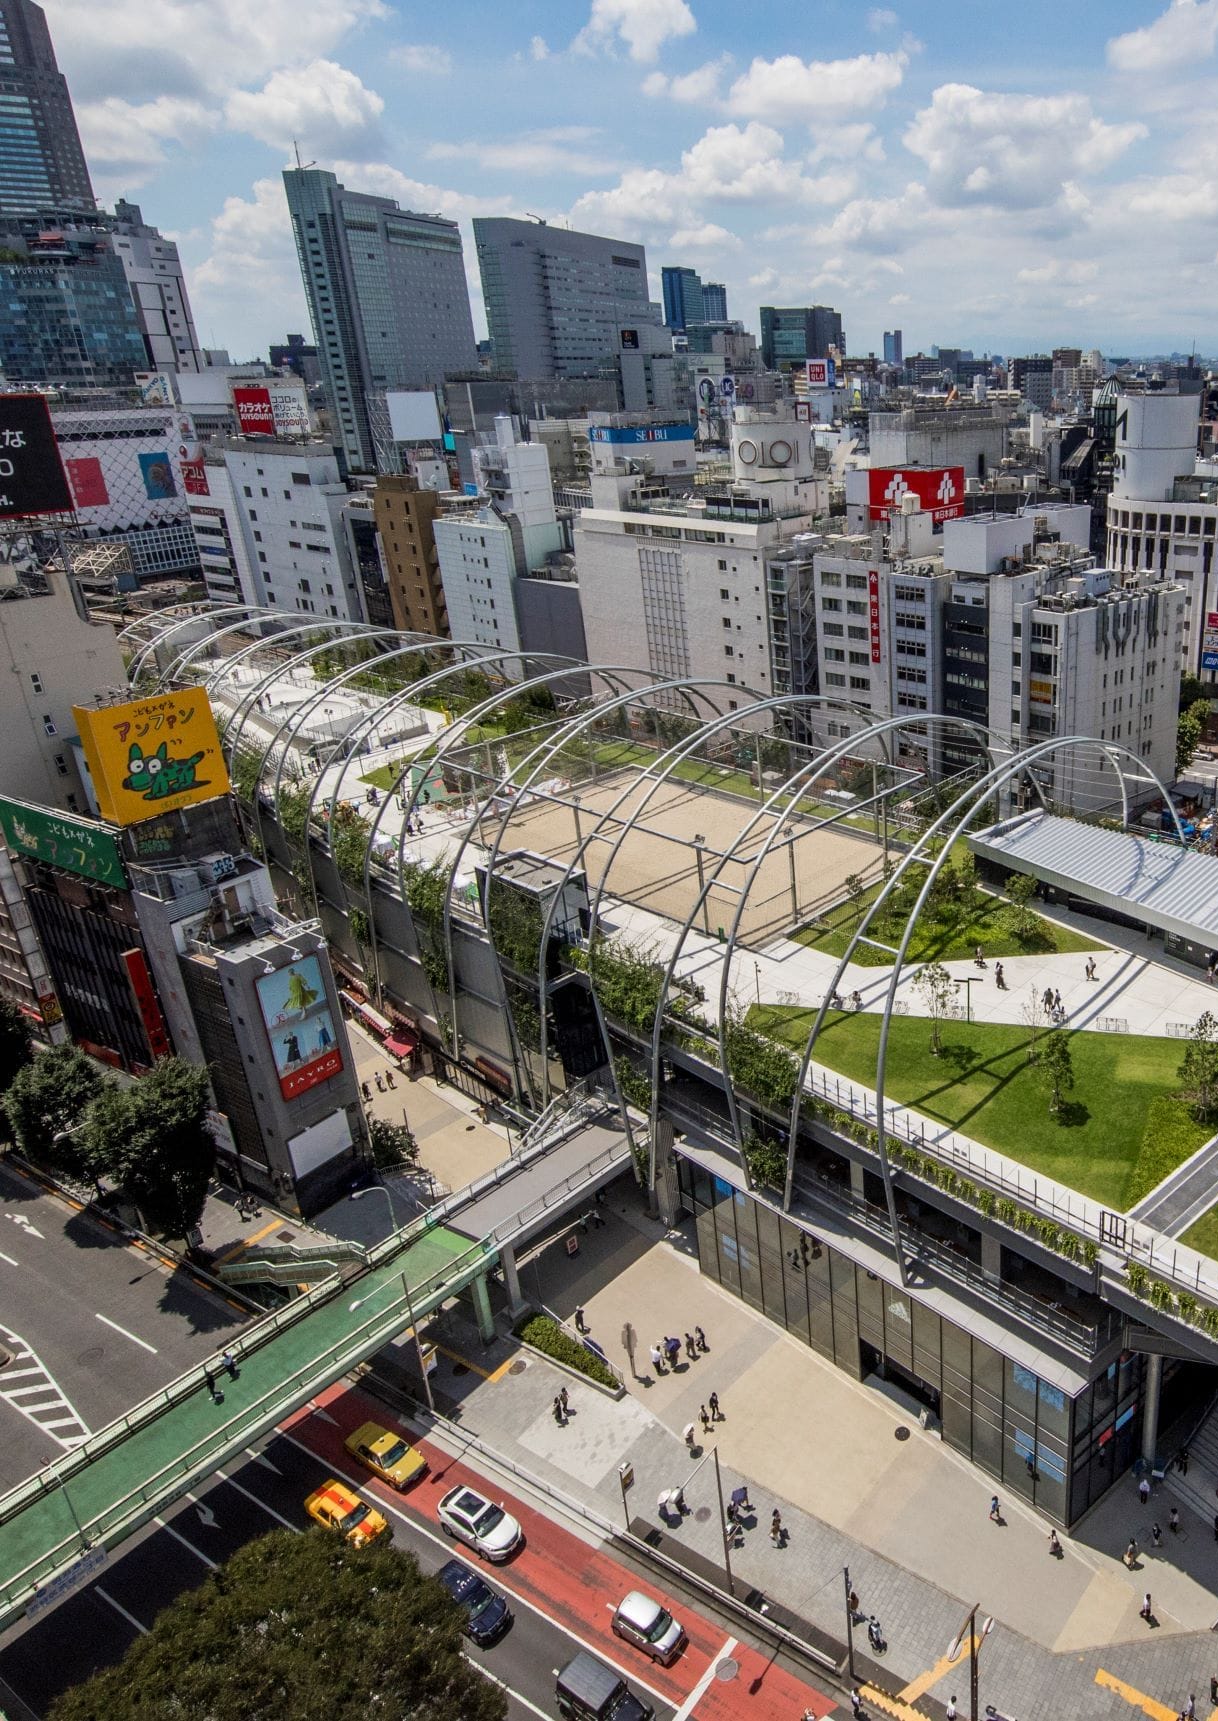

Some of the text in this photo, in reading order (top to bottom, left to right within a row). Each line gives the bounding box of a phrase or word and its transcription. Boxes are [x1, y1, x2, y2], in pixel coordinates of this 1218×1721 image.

[239, 403, 270, 413] カラオケ
[635, 429, 668, 442] SEIBU
[113, 707, 195, 743] アンファン
